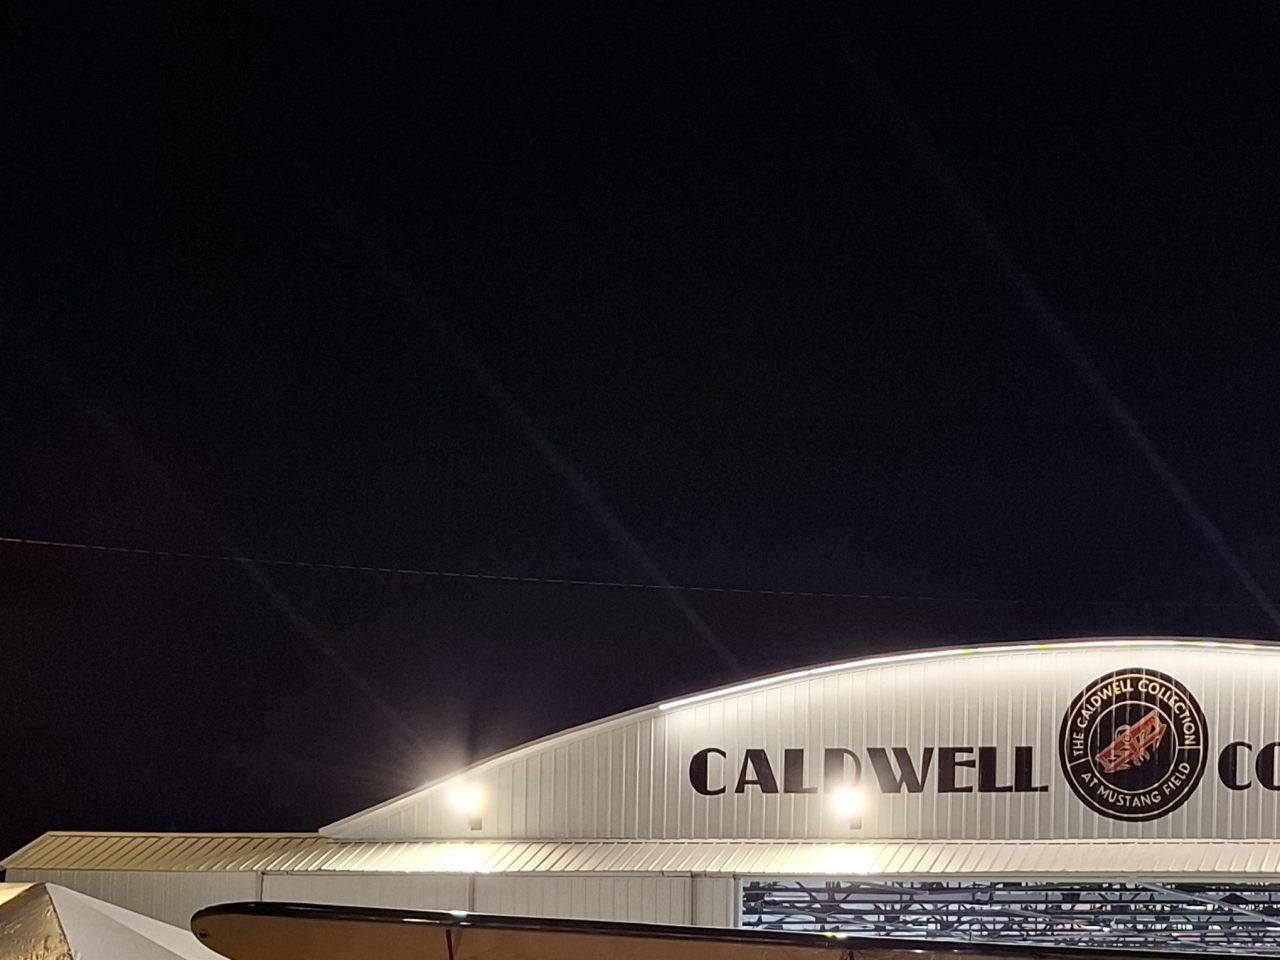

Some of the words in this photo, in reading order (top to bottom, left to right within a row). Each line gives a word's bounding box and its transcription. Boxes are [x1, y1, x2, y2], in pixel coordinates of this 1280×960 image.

[1077, 679, 1135, 729] CALDWELL
[1137, 680, 1197, 746] COLLECTION
[1073, 731, 1085, 756] THE
[689, 746, 1049, 796] CALDWELL
[1081, 772, 1097, 787] AT
[1097, 784, 1162, 808] MUSTANG
[1163, 761, 1191, 795] FIELD
